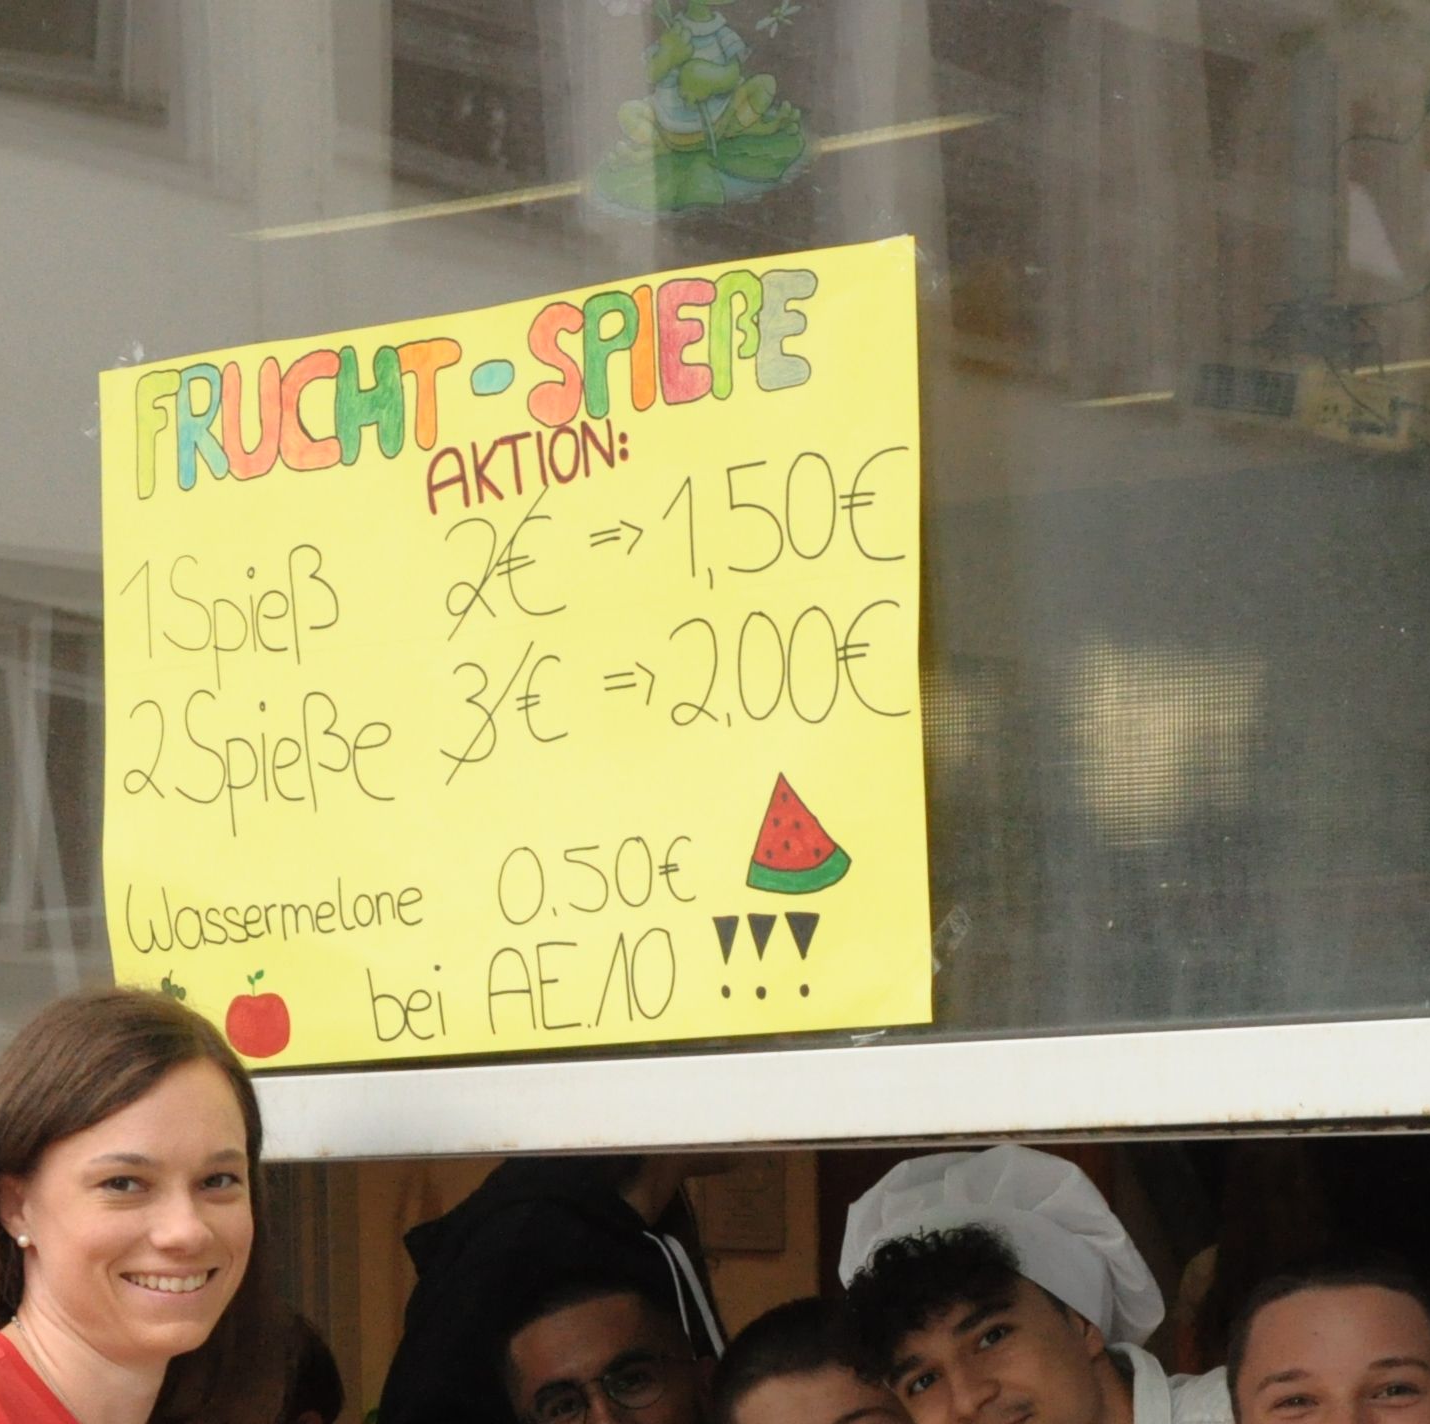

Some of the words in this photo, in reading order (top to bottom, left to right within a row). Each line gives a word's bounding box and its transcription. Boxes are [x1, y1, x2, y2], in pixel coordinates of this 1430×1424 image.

[426, 418, 629, 514] AKTION:
[662, 445, 909, 589] 1,50€
[669, 599, 911, 727] 2,00€
[125, 877, 423, 953] Wassermelone
[366, 964, 447, 1042] bei
